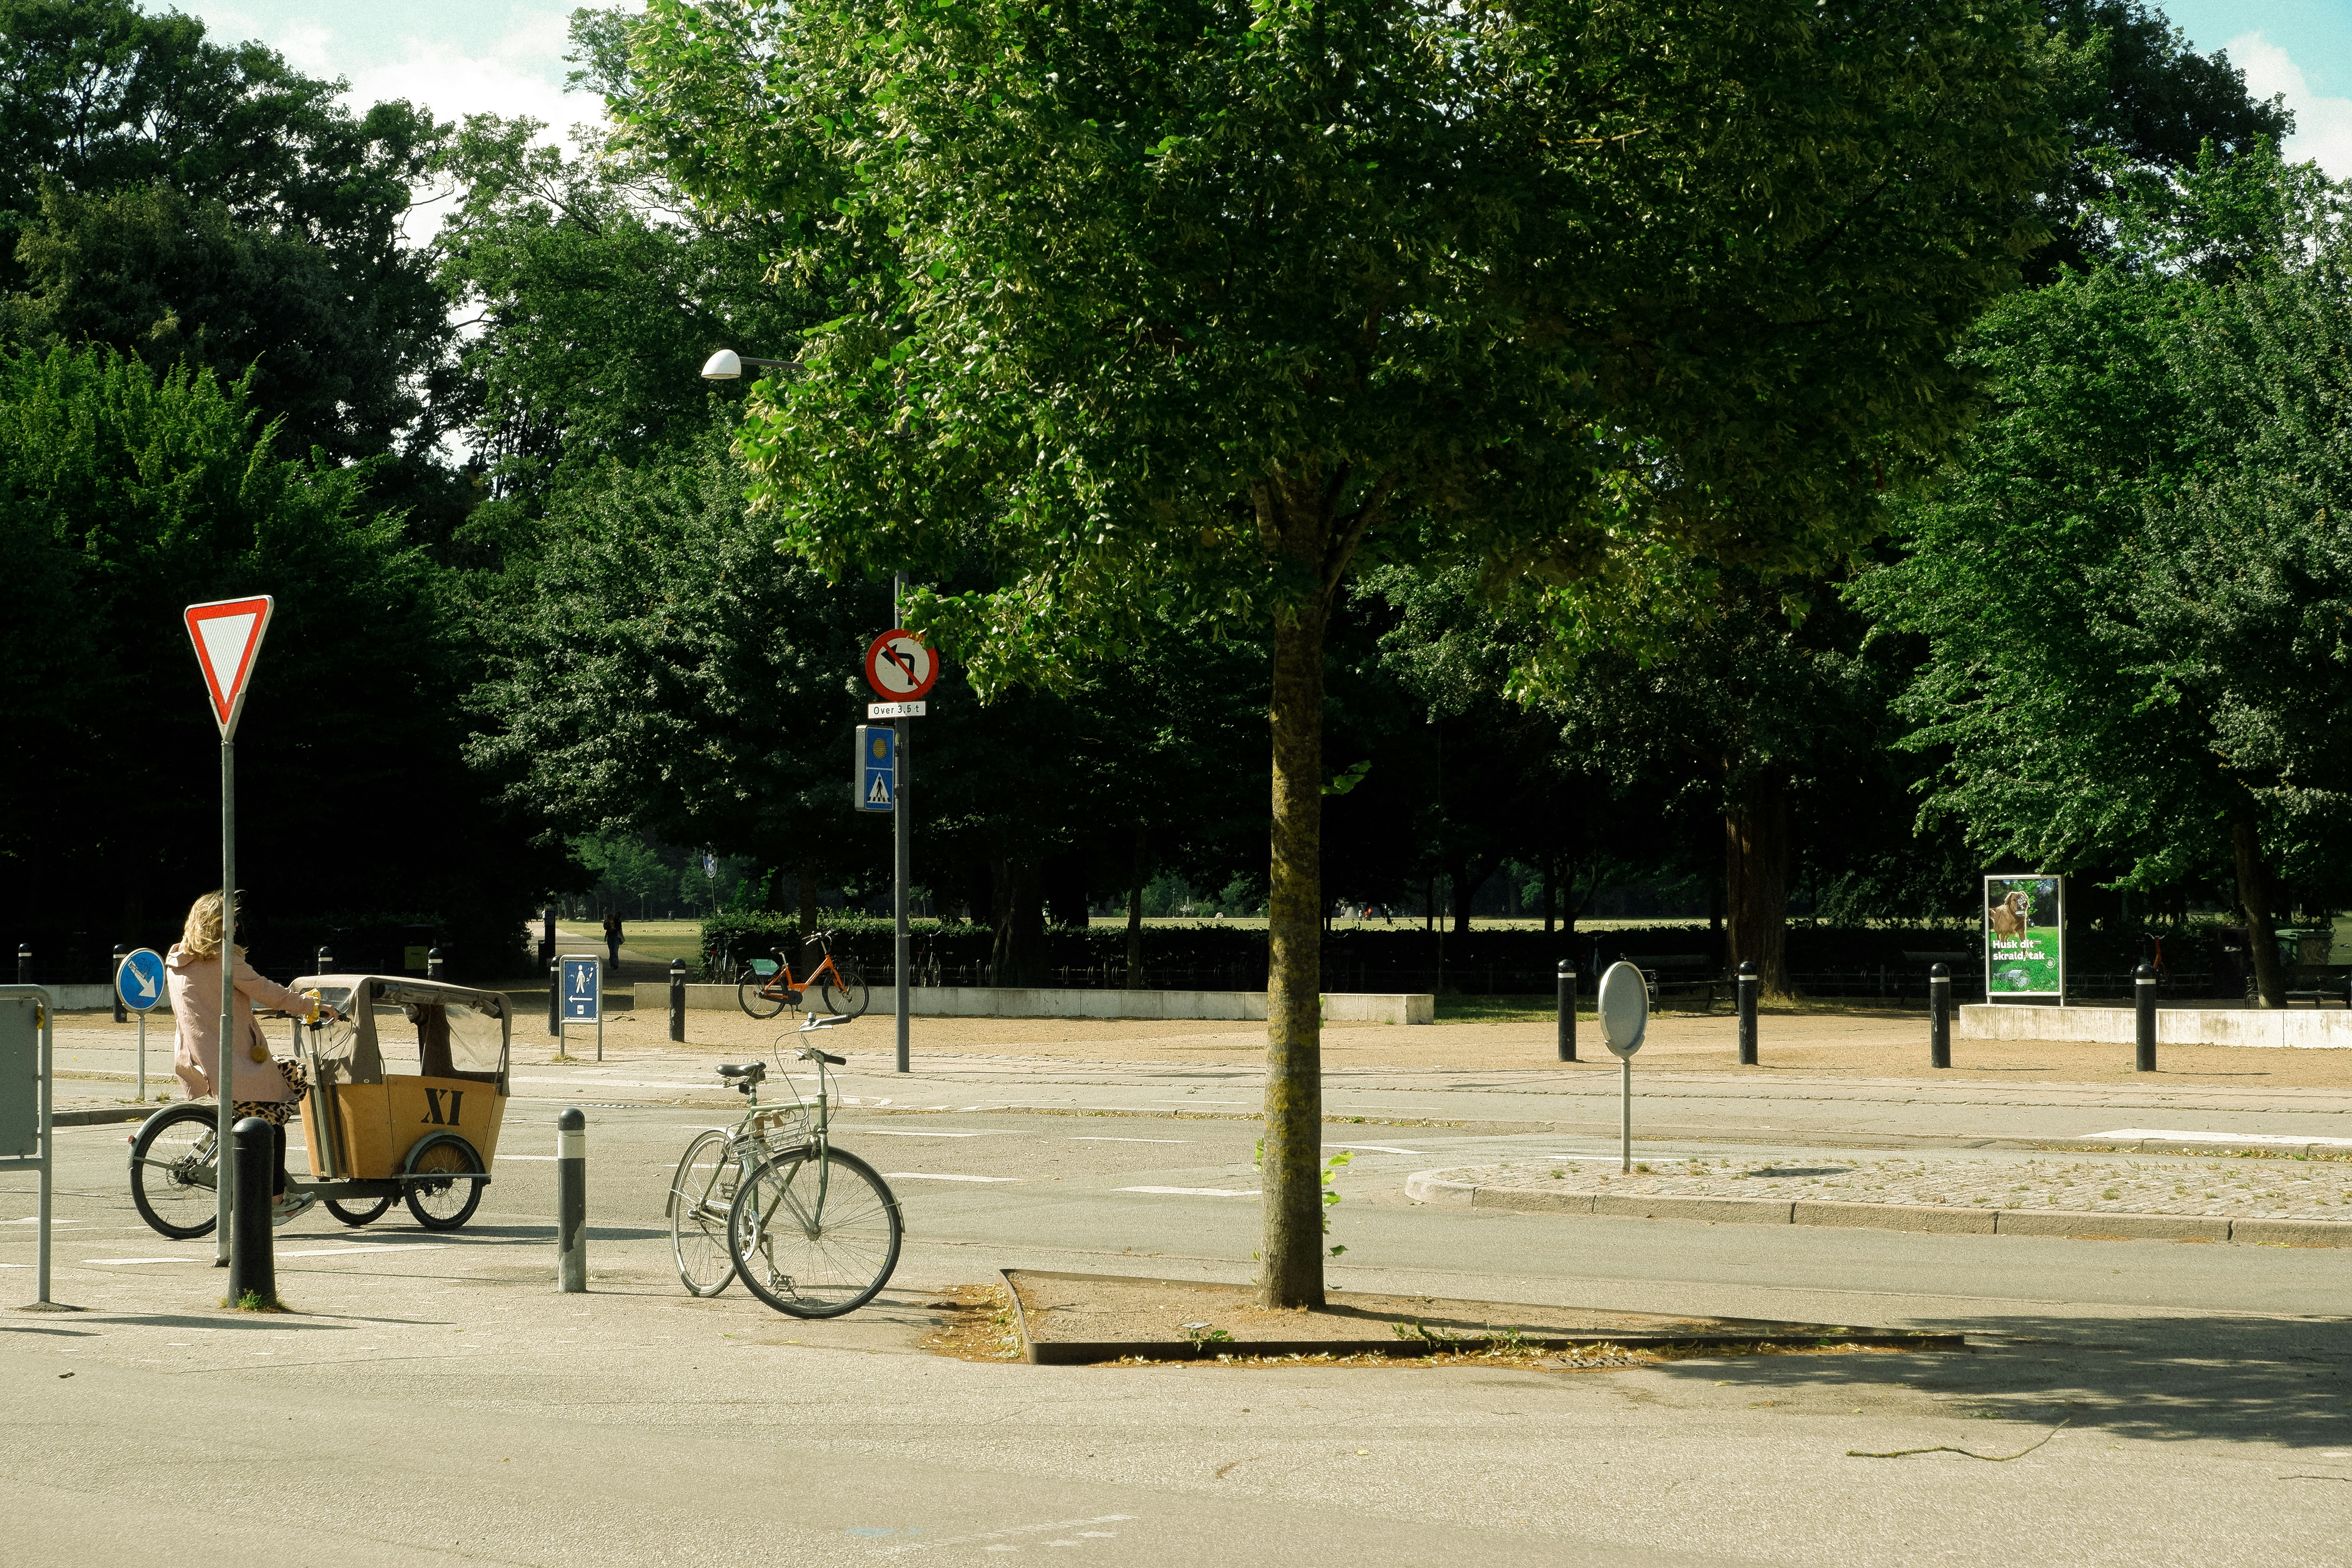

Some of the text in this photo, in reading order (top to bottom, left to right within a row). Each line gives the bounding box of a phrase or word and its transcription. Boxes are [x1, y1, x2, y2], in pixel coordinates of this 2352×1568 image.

[874, 704, 919, 715] Over 3,5 t
[1993, 939, 2034, 948] Husk dit
[1993, 951, 2045, 962] skrald, tak
[421, 1087, 464, 1126] XI
